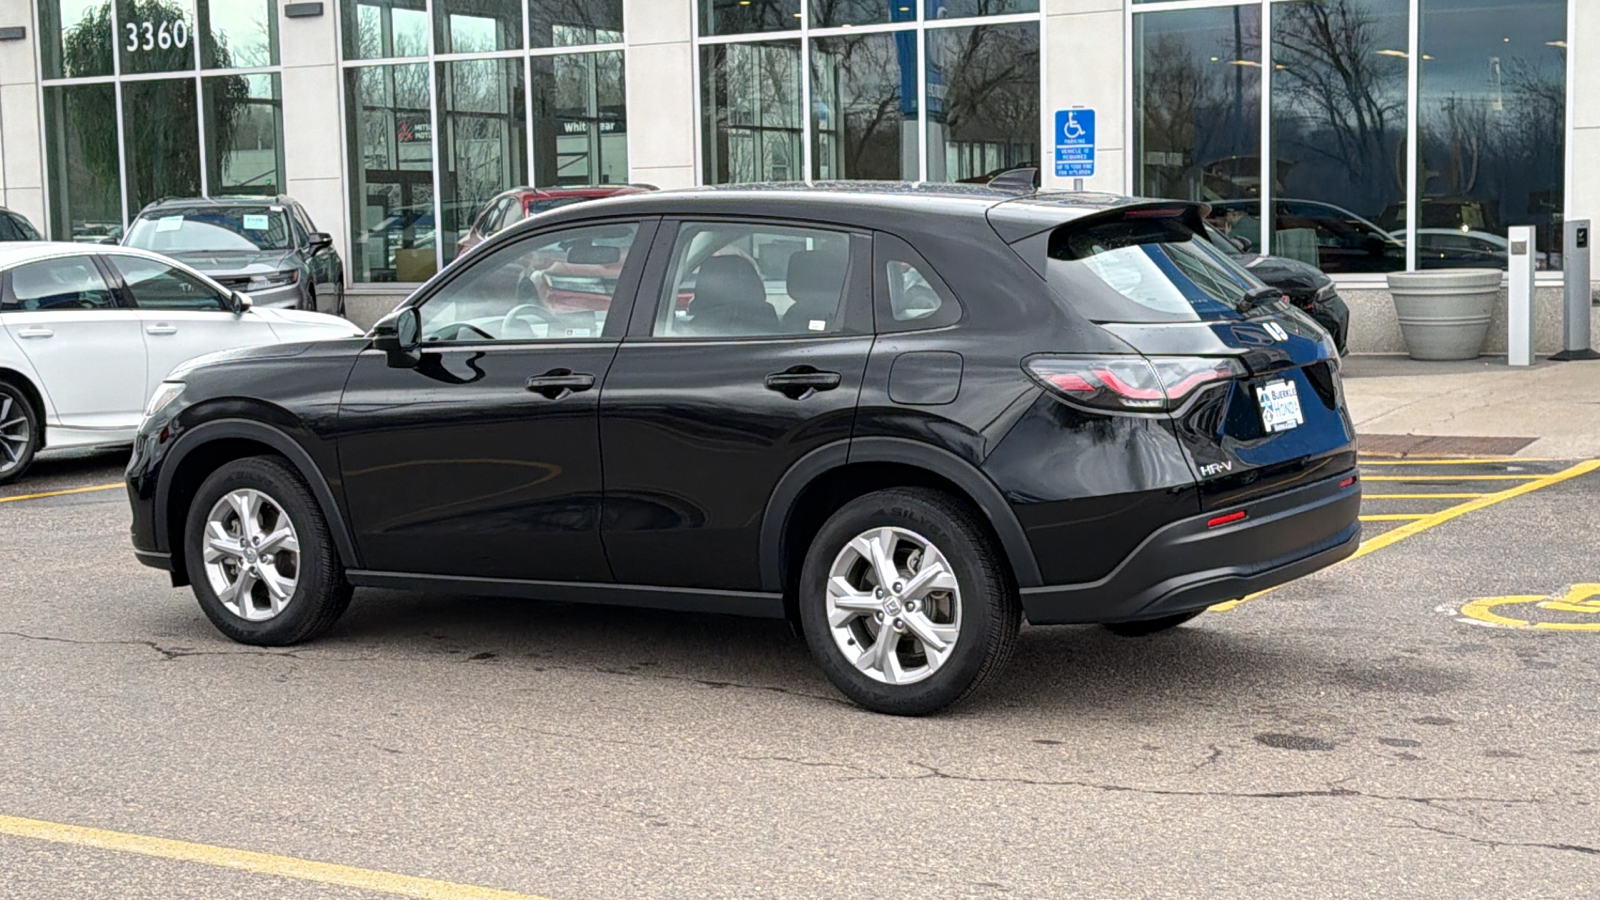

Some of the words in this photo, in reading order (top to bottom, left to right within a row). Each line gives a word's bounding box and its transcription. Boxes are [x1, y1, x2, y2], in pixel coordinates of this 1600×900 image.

[126, 19, 187, 52] 3360
[564, 121, 588, 132] Whit
[1273, 401, 1299, 418] HONDA
[1200, 460, 1232, 476] HR-V
